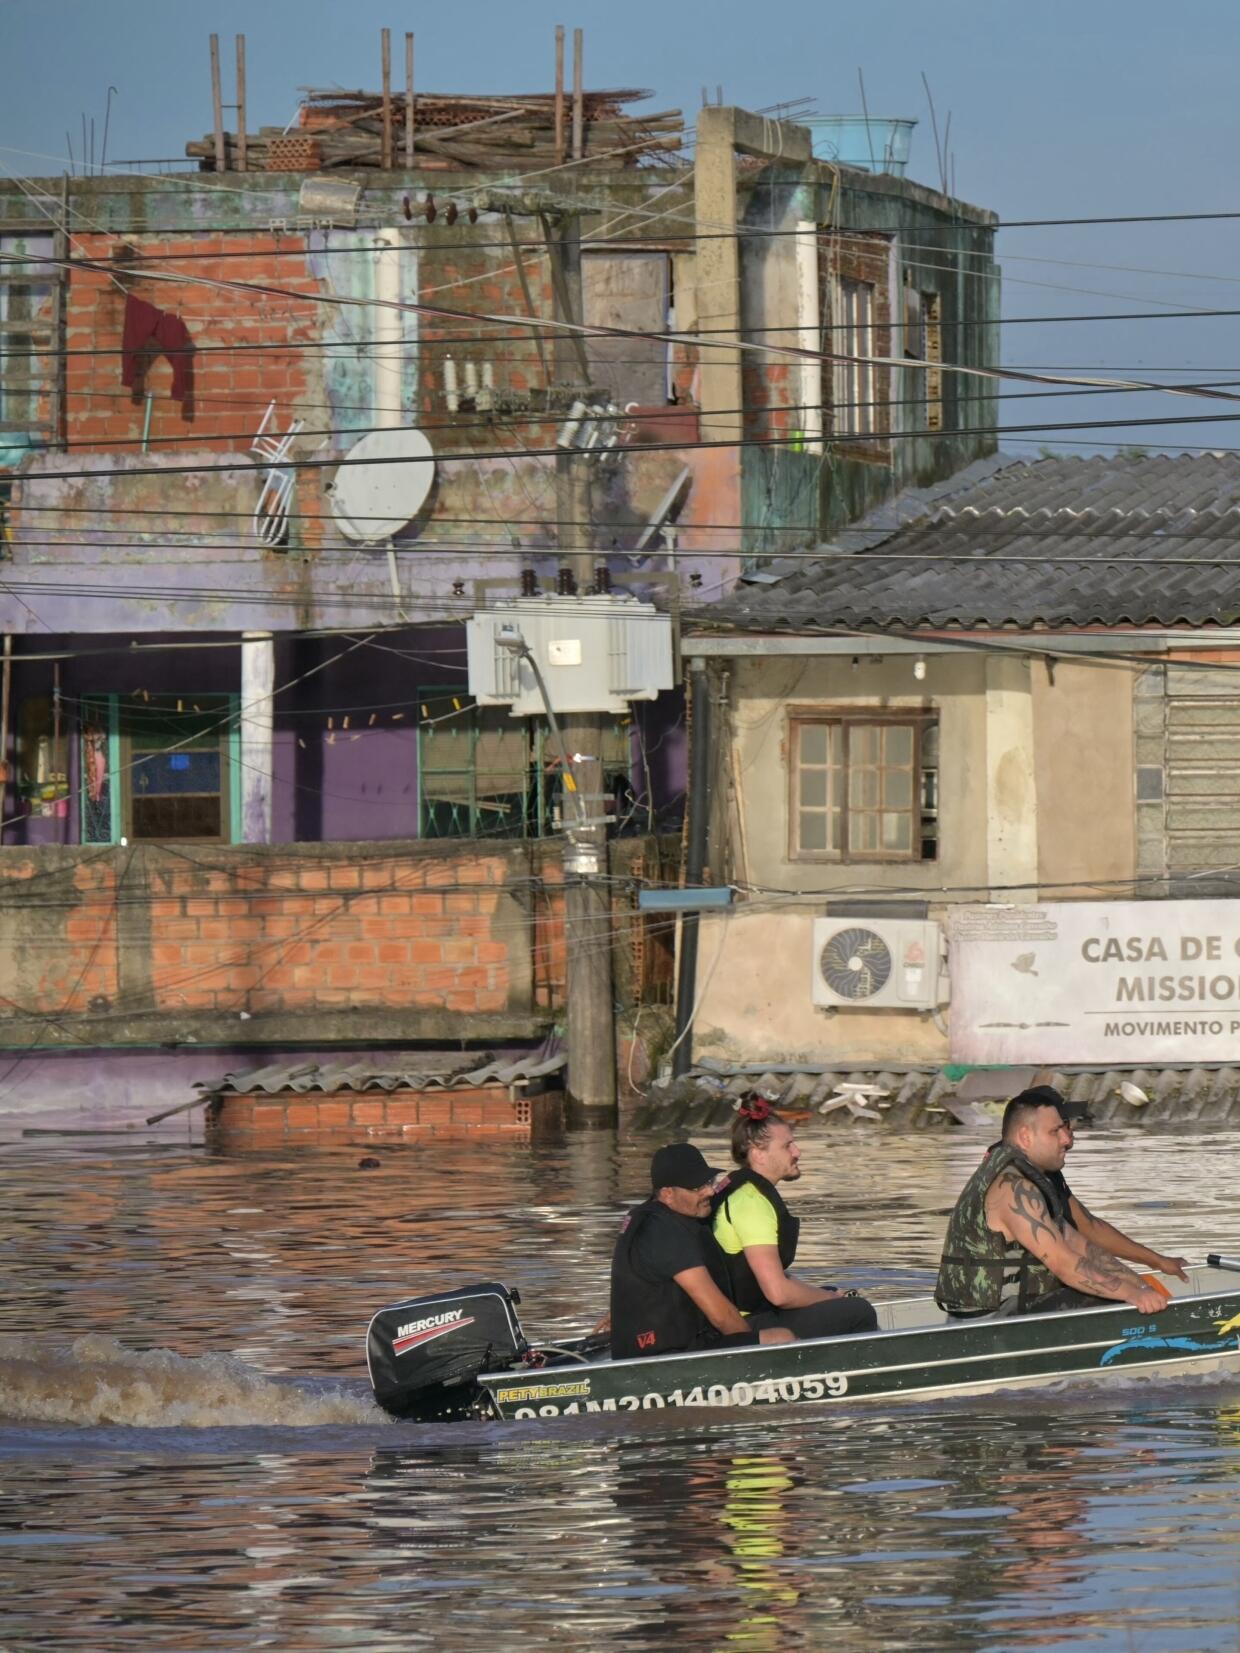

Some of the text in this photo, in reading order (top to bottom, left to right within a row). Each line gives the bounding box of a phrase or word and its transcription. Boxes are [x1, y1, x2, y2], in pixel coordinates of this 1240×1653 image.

[1081, 936, 1168, 963] CASA
[1180, 936, 1222, 961] DE
[1104, 1020, 1223, 1037] MOVIMENTO
[397, 1309, 464, 1338] MERCURY
